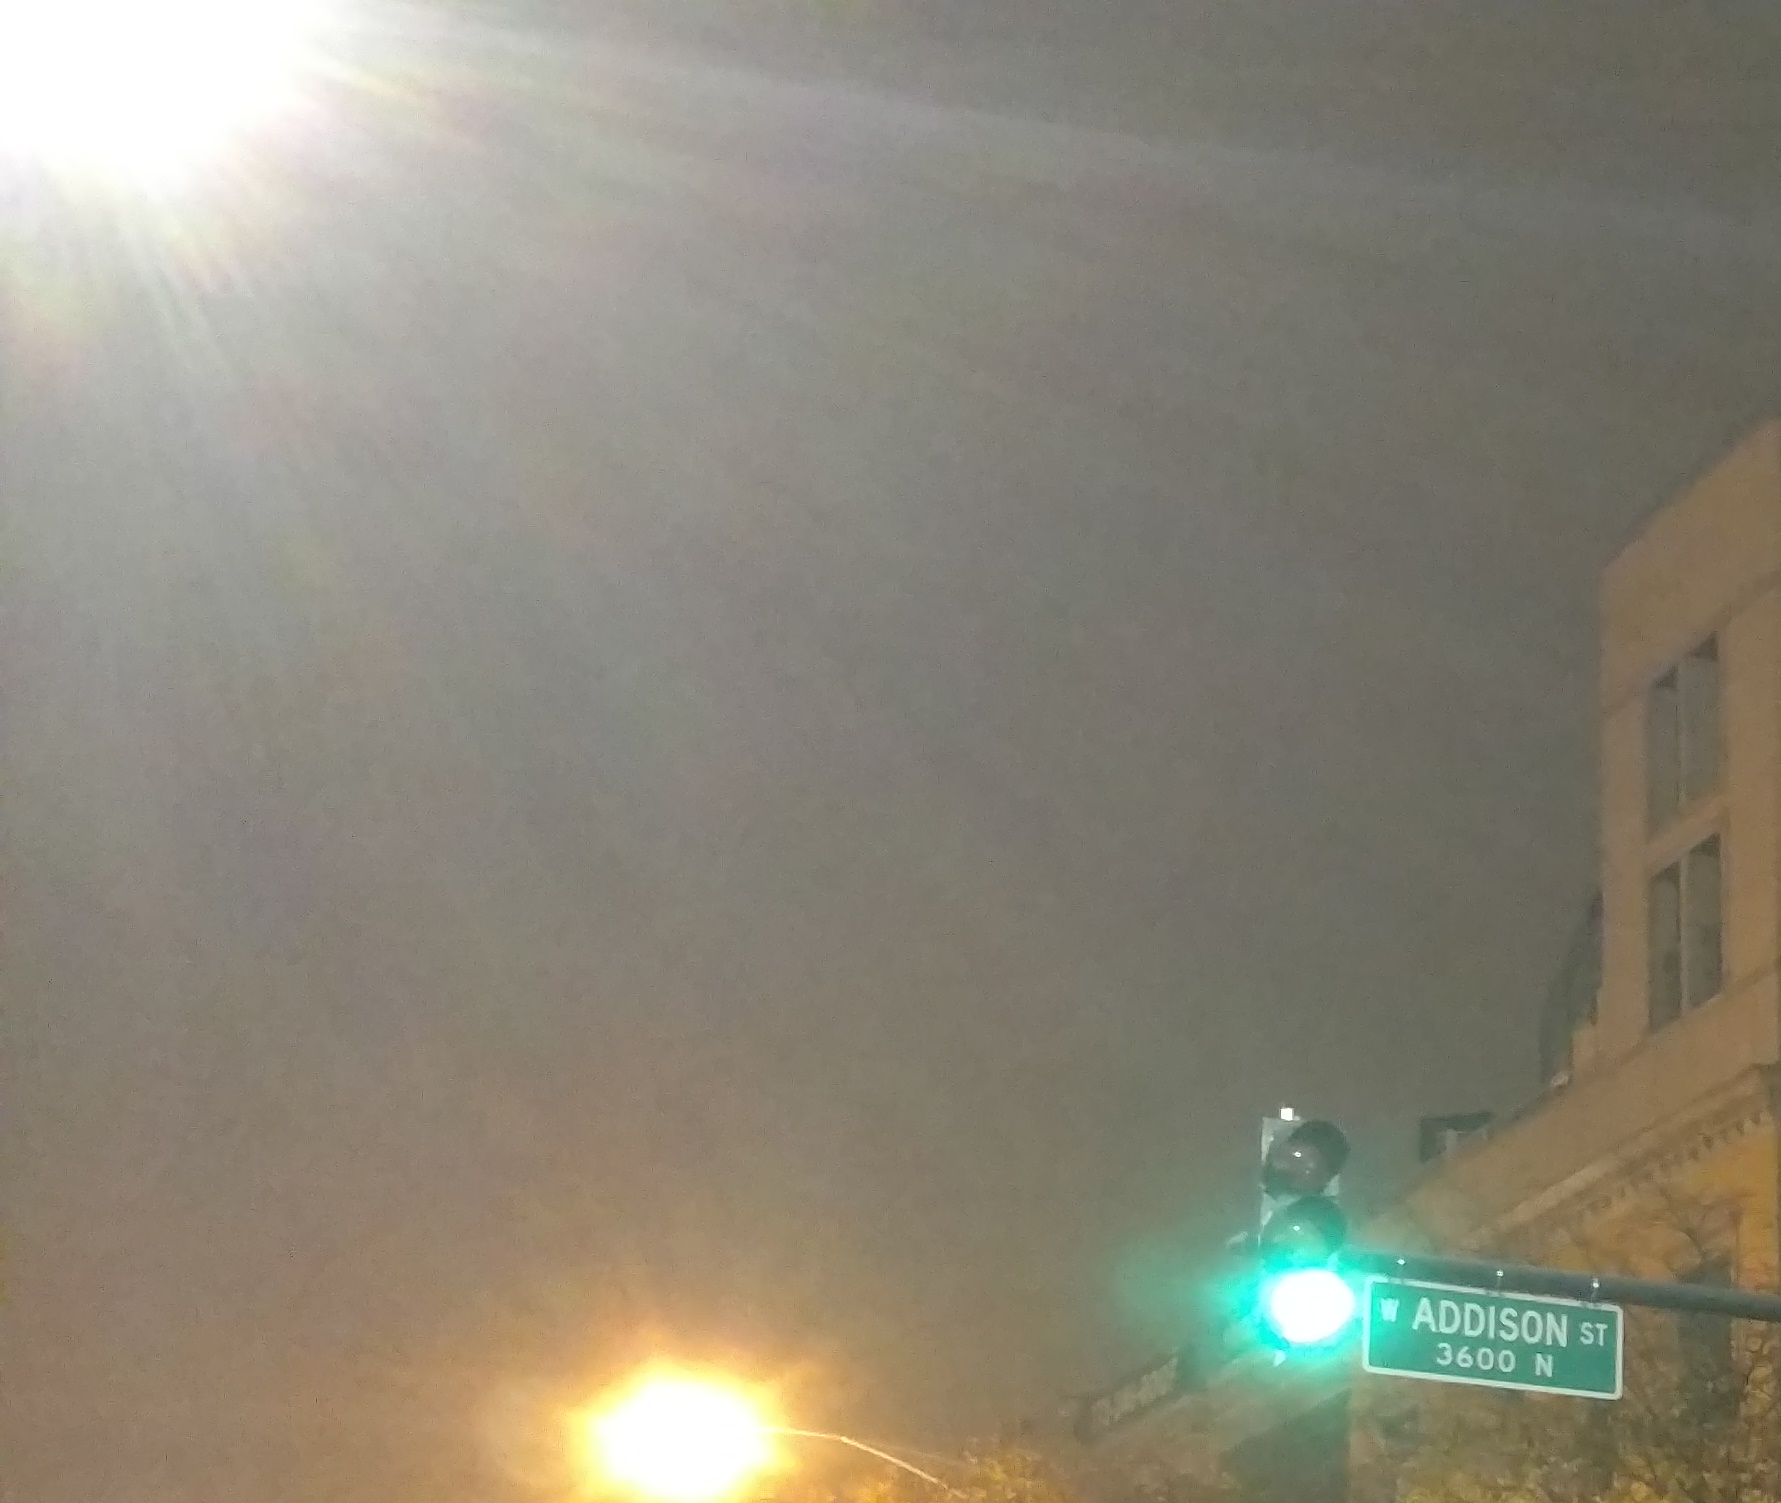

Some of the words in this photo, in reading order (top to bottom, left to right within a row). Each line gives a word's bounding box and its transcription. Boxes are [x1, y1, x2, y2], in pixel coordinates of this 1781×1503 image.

[1380, 1298, 1399, 1322] W
[1412, 1297, 1568, 1347] ADDISON
[1579, 1322, 1608, 1346] ST
[1436, 1342, 1516, 1373] 3600
[1535, 1353, 1554, 1377] N
